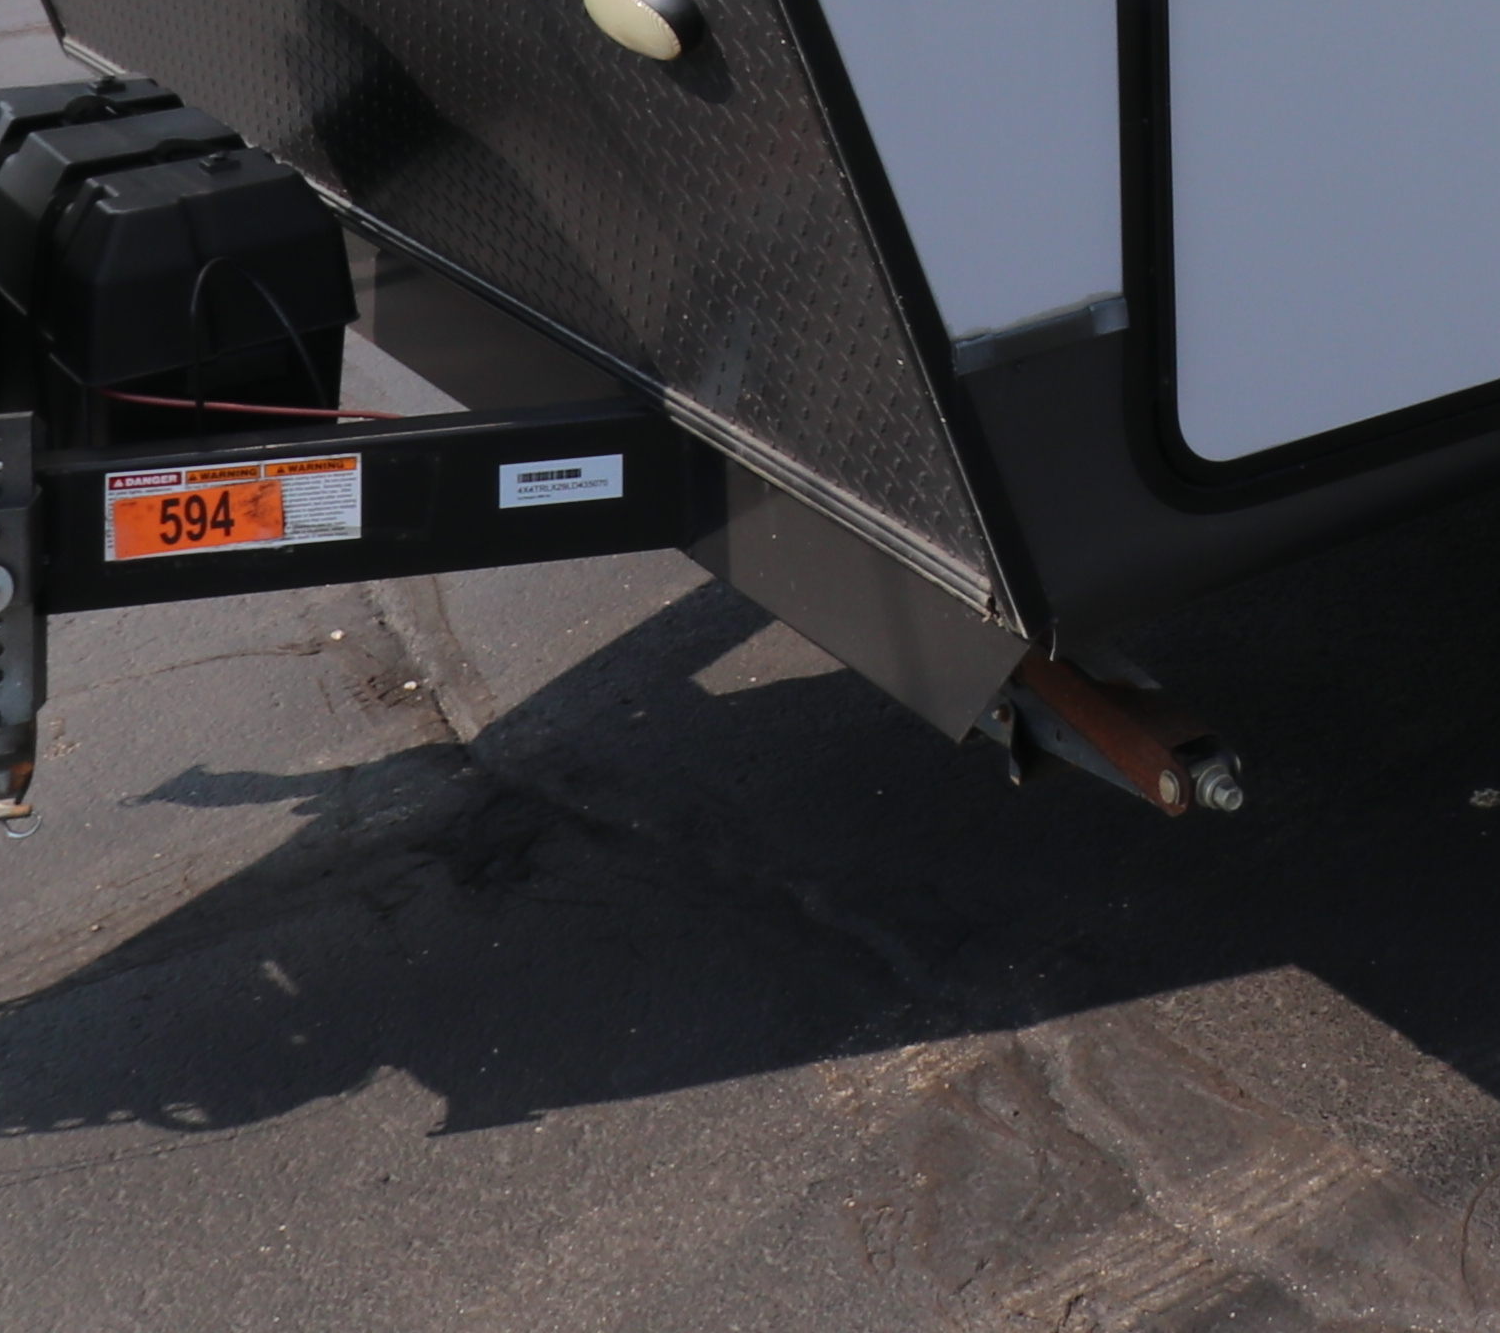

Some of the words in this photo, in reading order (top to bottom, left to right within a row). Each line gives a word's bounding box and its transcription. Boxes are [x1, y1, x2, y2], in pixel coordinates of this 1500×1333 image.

[288, 460, 344, 472] WARNING
[125, 474, 178, 487] DANGER
[200, 468, 257, 481] WARNING
[160, 490, 234, 545] 594
